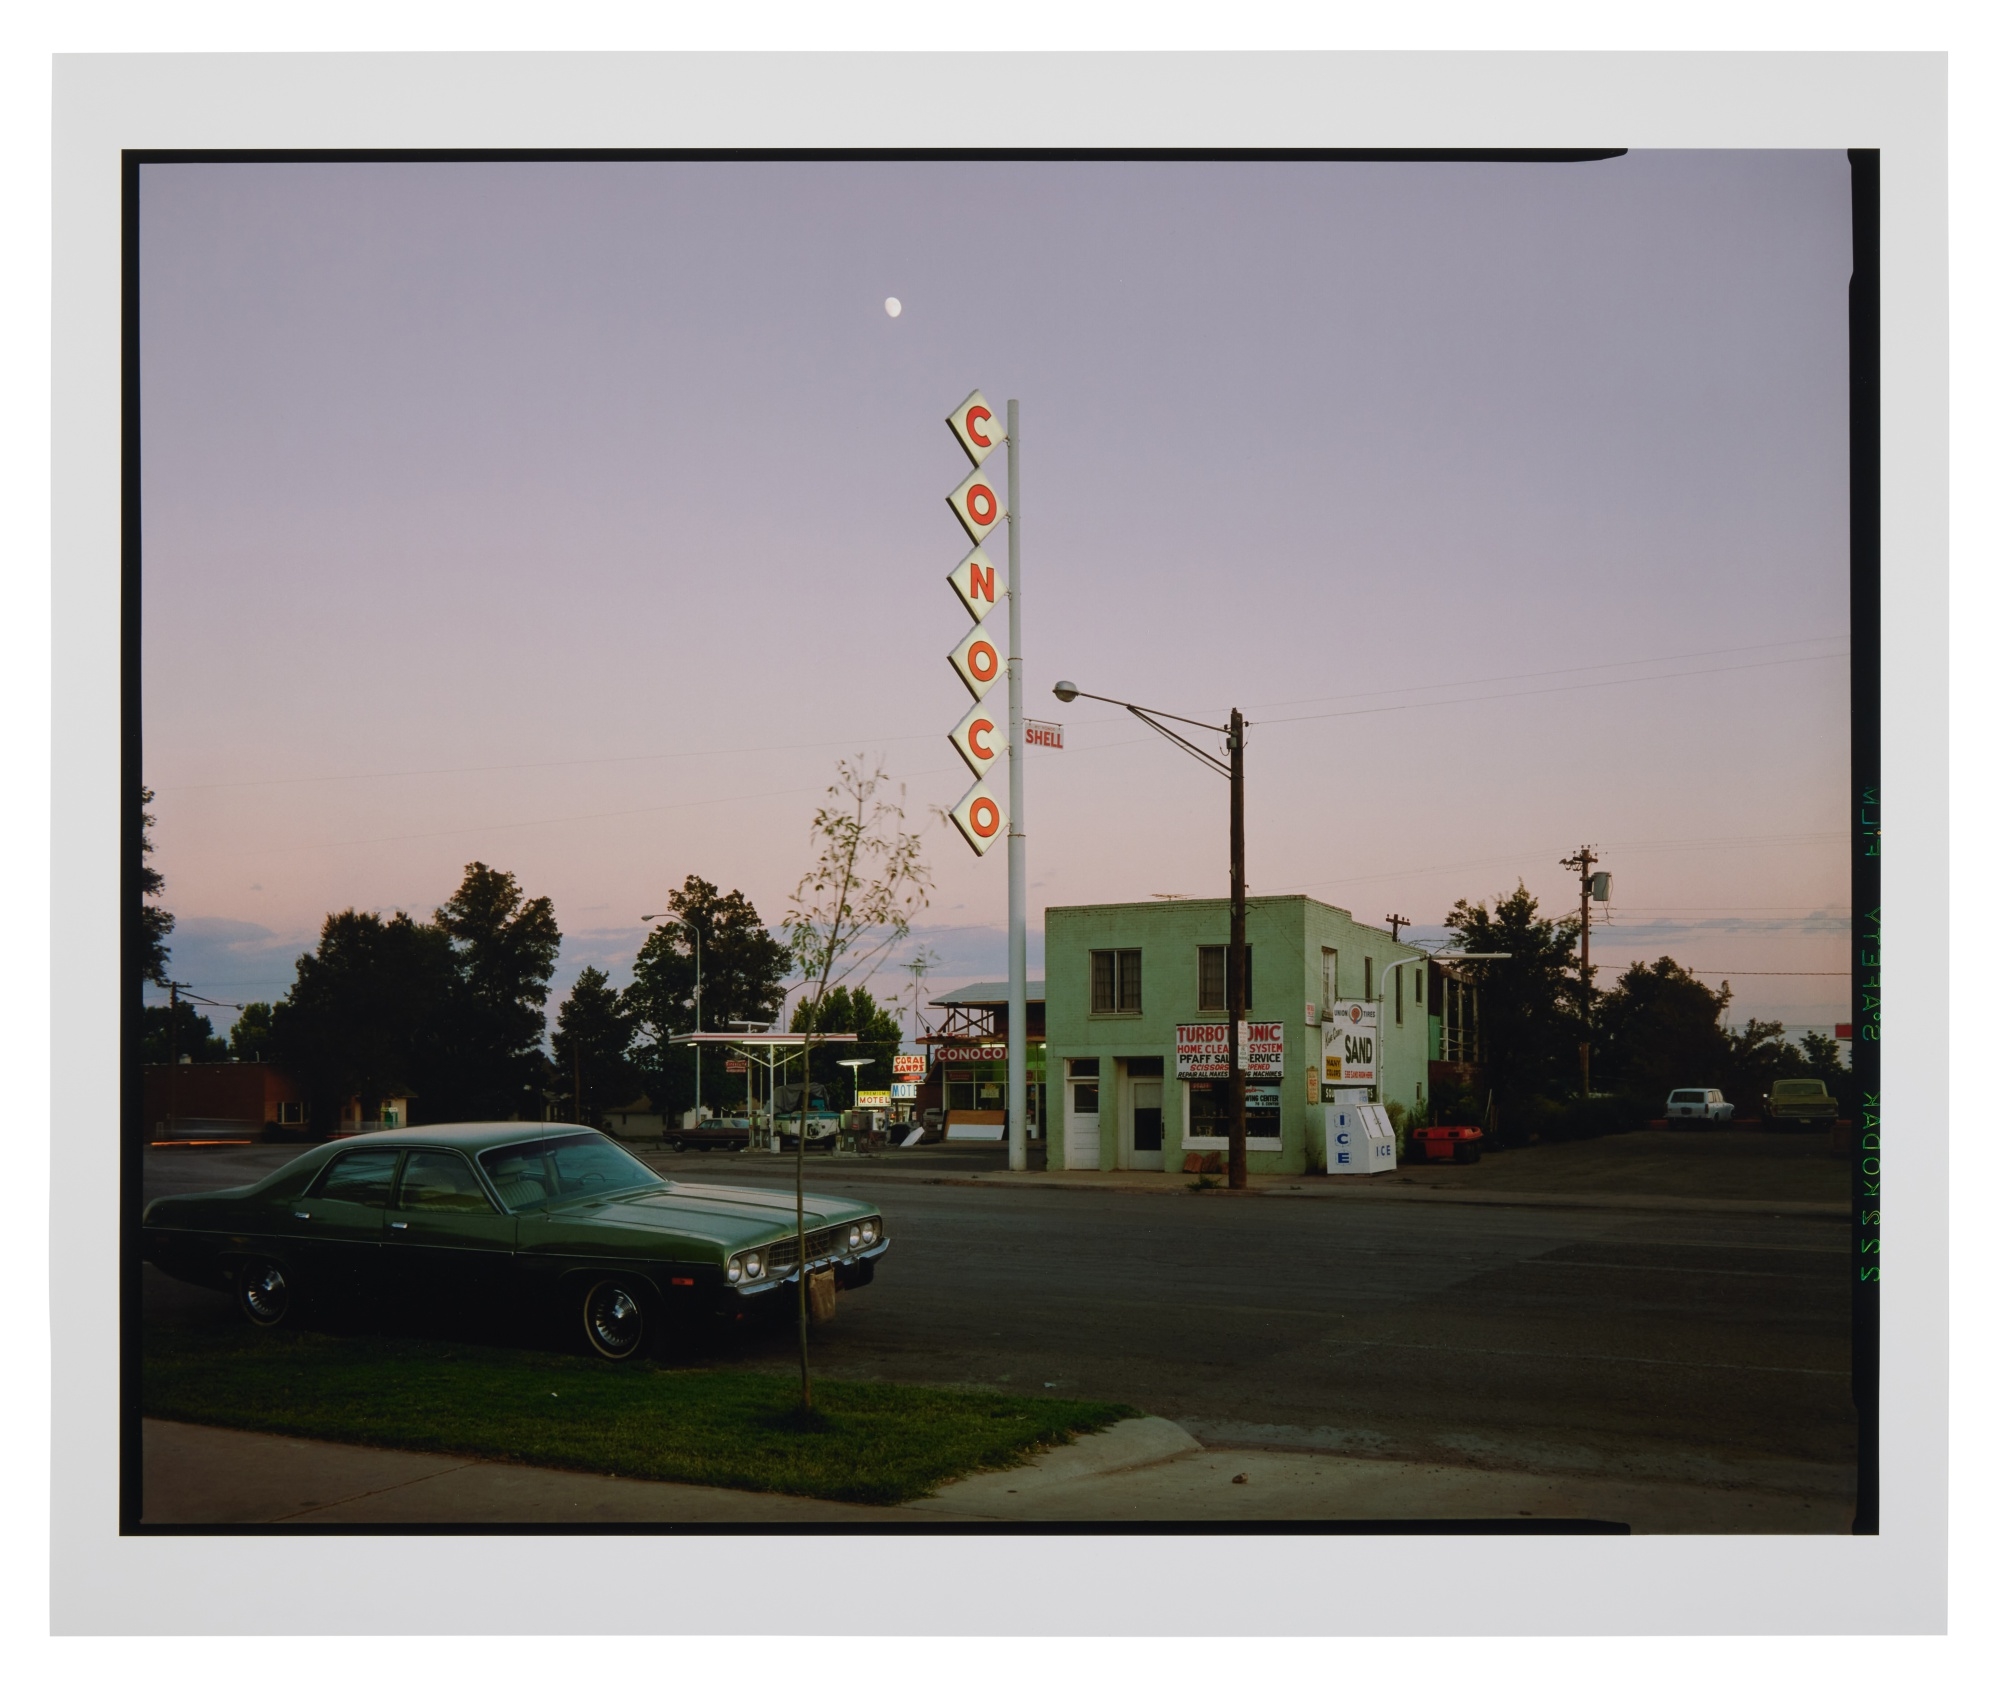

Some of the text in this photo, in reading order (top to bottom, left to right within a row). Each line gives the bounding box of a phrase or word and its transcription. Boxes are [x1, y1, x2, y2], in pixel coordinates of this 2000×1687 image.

[966, 405, 999, 837] CONOCO
[1025, 728, 1063, 749] SHELL
[1334, 1009, 1376, 1018] UNION TIRES
[1177, 1044, 1203, 1054] HOME
[1249, 1043, 1283, 1053] SYSTEM
[1345, 1034, 1373, 1064] SAND
[937, 1048, 1003, 1060] CONOCO
[1180, 1054, 1212, 1064] PFAFF
[895, 1056, 925, 1065] CORAL
[1326, 1059, 1341, 1067] MANY
[894, 1064, 924, 1073] SANDS
[1190, 1063, 1230, 1072] SCISSORS
[859, 1096, 891, 1104] MOTEL
[1259, 1094, 1279, 1102] CENTER
[1336, 1114, 1350, 1164] ICE
[1376, 1144, 1391, 1157] ICE
